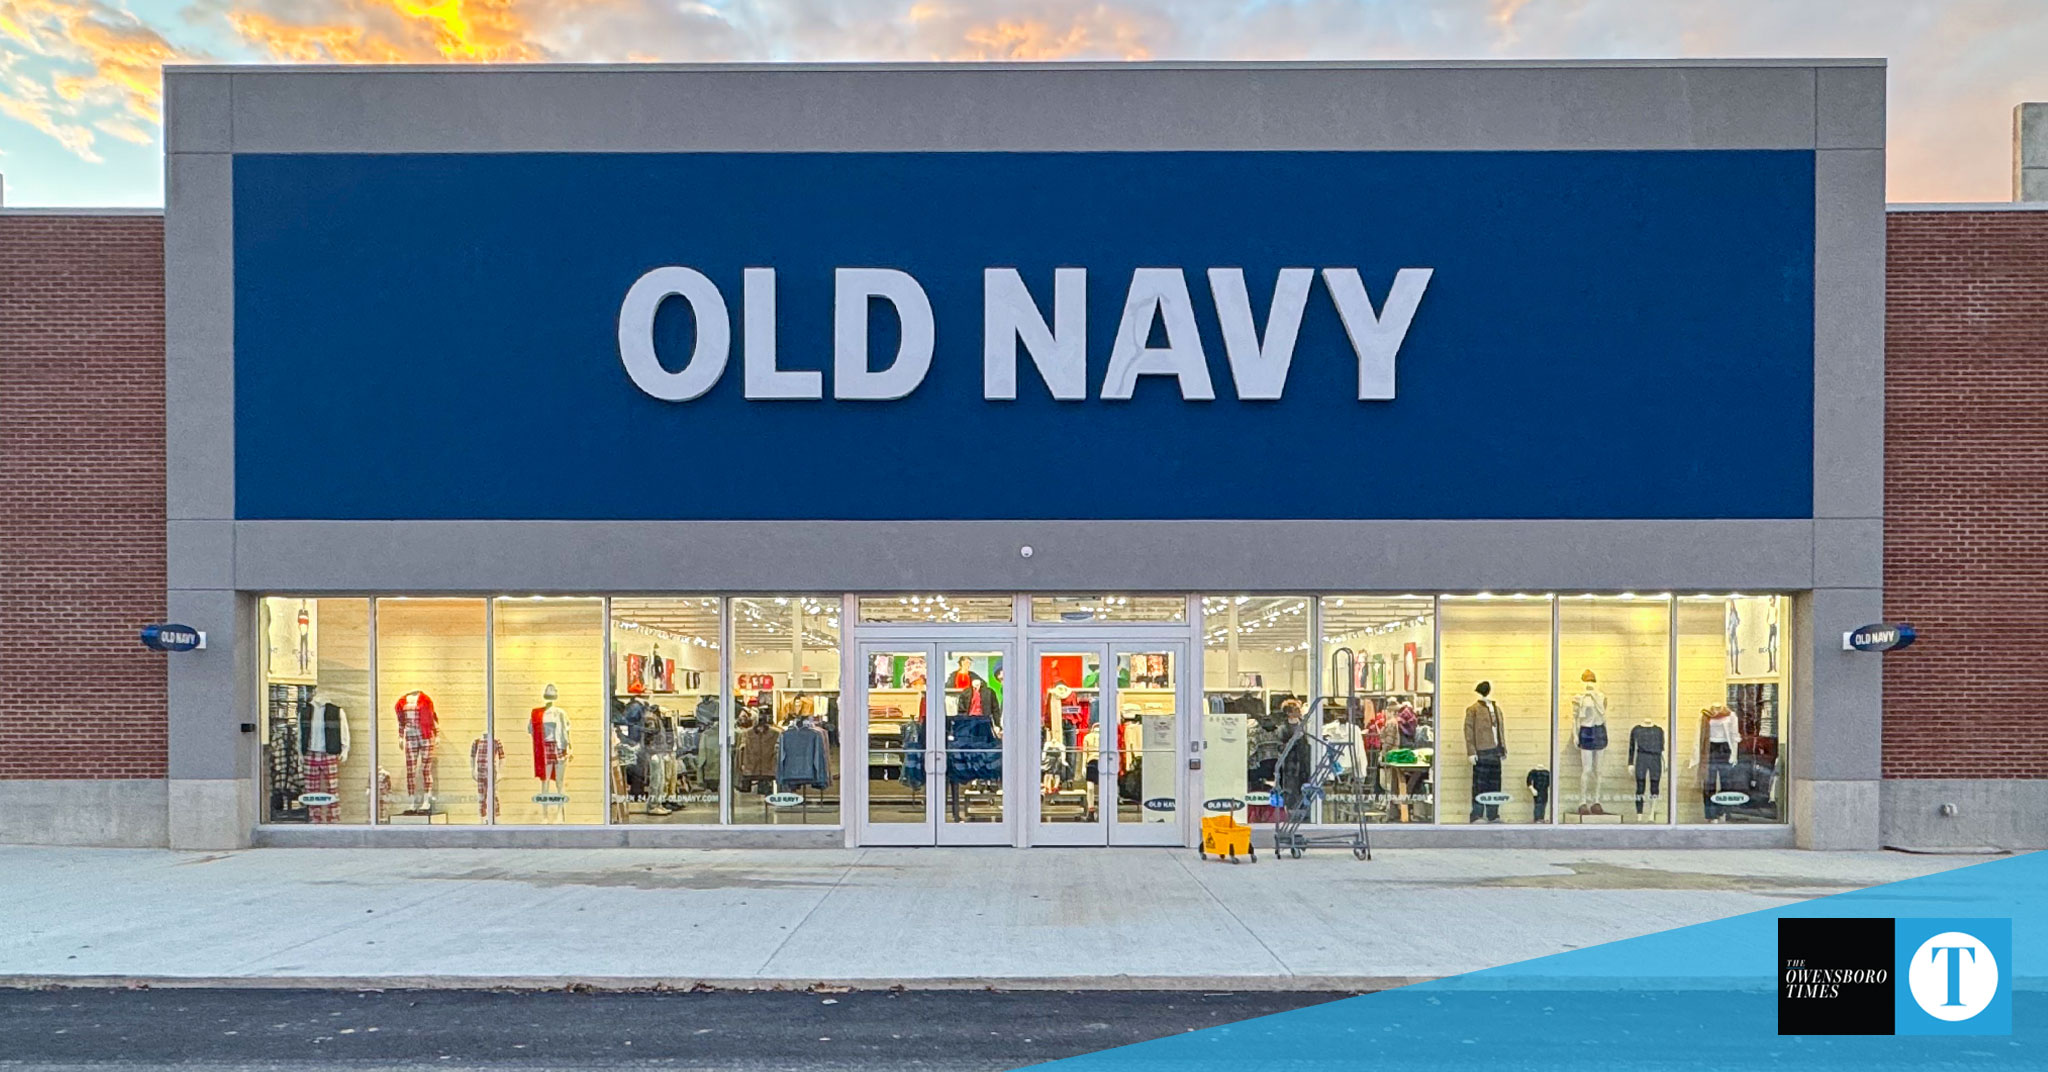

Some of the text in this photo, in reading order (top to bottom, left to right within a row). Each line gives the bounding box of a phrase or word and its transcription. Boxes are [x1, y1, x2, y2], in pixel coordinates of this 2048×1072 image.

[617, 266, 1434, 402] OLD NAVY
[161, 631, 196, 645] OLD NAVY
[1855, 631, 1895, 645] OLD NAVY
